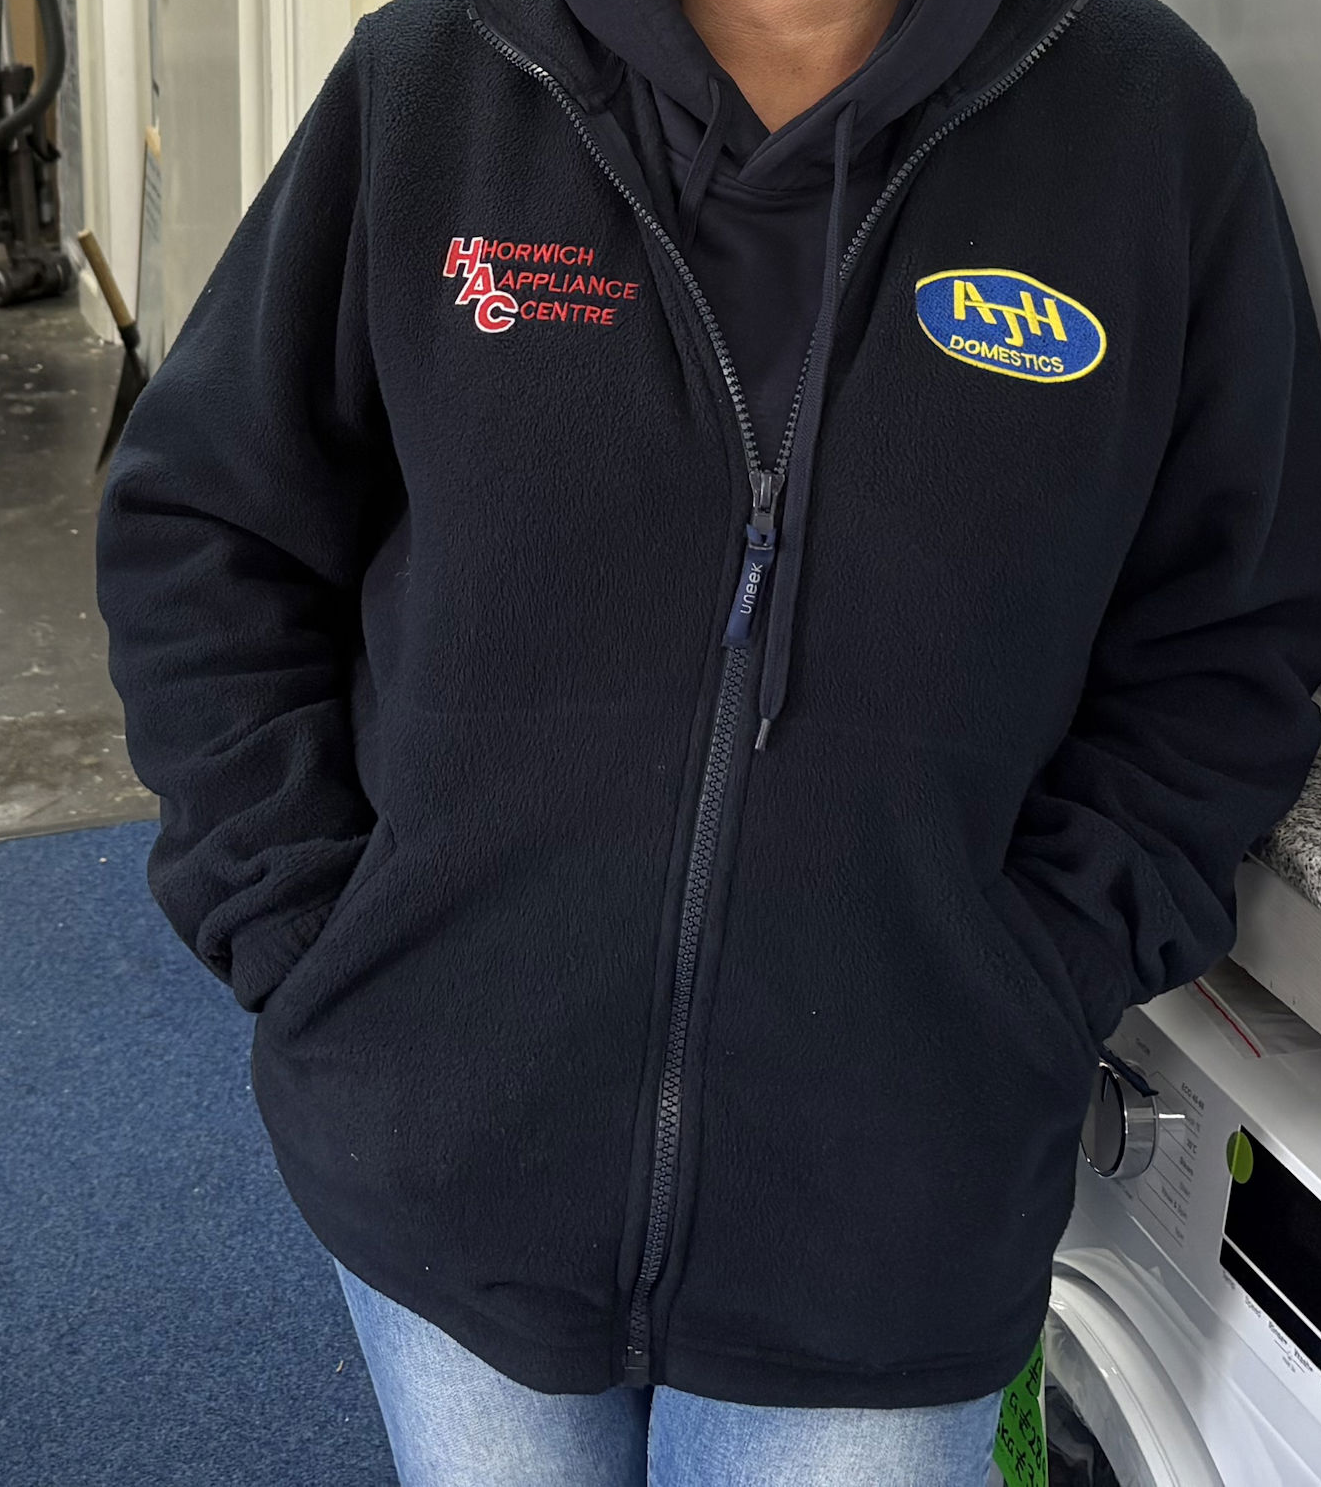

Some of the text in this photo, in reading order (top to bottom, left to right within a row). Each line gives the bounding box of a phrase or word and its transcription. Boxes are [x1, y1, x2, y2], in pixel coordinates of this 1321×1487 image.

[481, 240, 595, 267] HORWICH
[497, 269, 640, 301] APPLIANCE
[519, 300, 618, 326] CENTRE
[949, 334, 1065, 374] DOMESTICS
[740, 562, 764, 615] uneek
